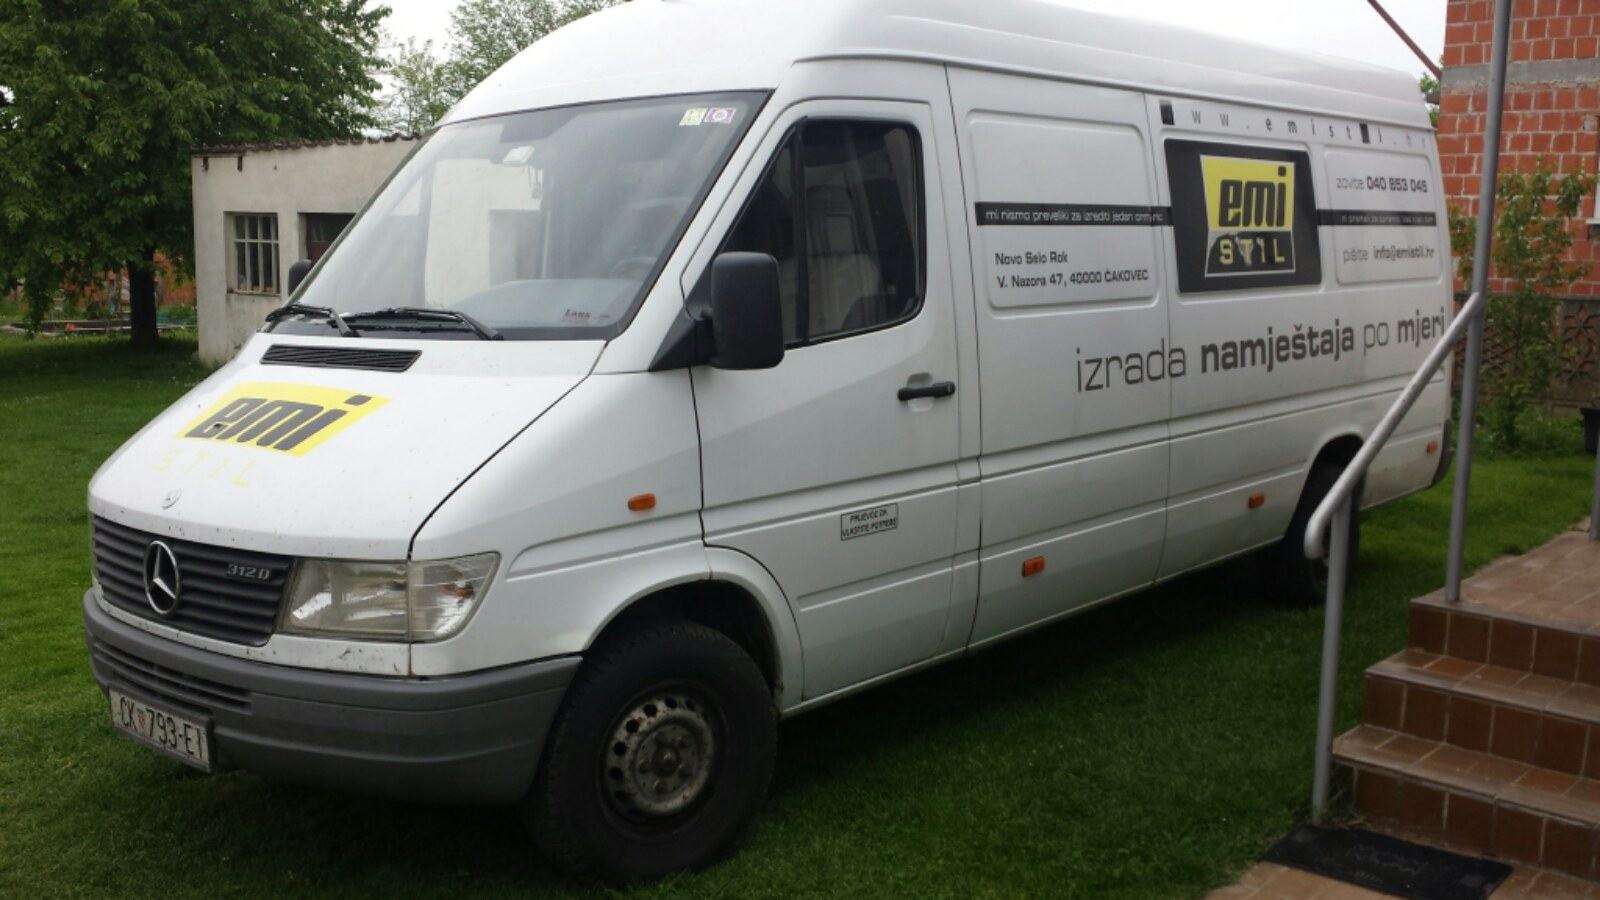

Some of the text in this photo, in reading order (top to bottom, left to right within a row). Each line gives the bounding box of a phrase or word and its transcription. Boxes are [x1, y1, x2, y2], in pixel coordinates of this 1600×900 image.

[1219, 165, 1287, 227] emi
[1367, 176, 1387, 191] 040
[994, 251, 1068, 265] Novo Selo Rok
[1219, 238, 1285, 266] STIL
[997, 269, 1149, 288] V. Nazora 47, 40000 ČAKOVEC
[1076, 306, 1445, 392] izrada namještaja po mjeri
[184, 393, 373, 451] emi
[120, 696, 138, 732] CK
